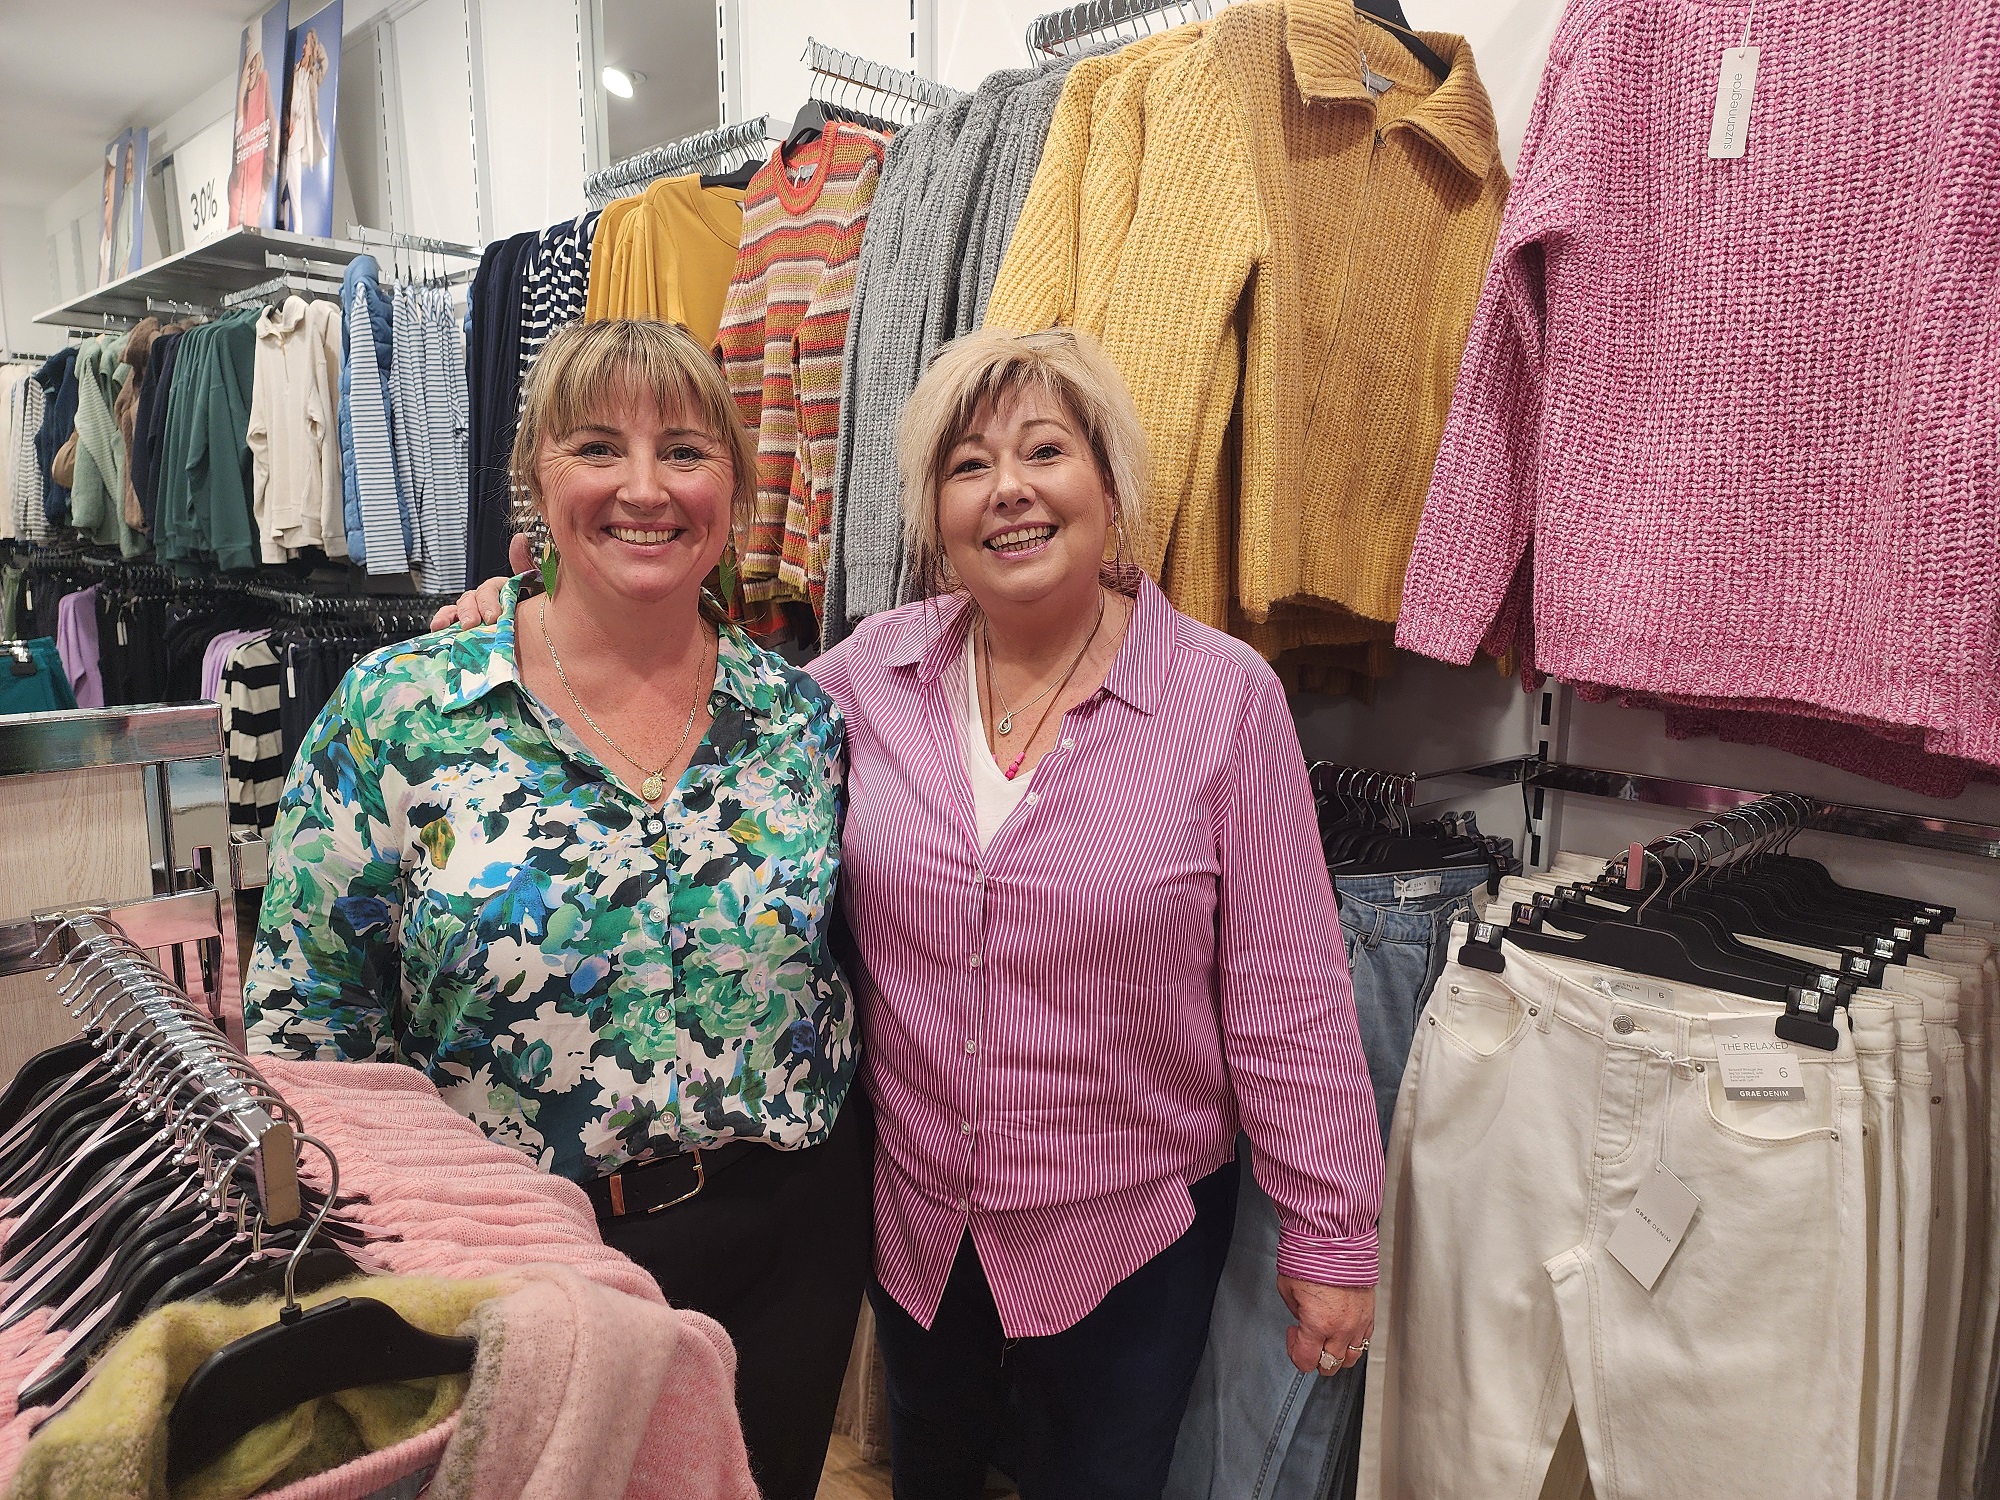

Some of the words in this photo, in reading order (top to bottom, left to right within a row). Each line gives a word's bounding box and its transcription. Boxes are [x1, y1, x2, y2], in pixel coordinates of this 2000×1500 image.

[1724, 73, 1743, 149] suzannegrae
[191, 178, 217, 231] 30%
[1721, 1043, 1741, 1051] THE
[1743, 1042, 1788, 1050] RELAXED
[1779, 1067, 1788, 1078] 6
[1635, 1207, 1651, 1225] GRAE
[1651, 1223, 1671, 1243] DENIM
